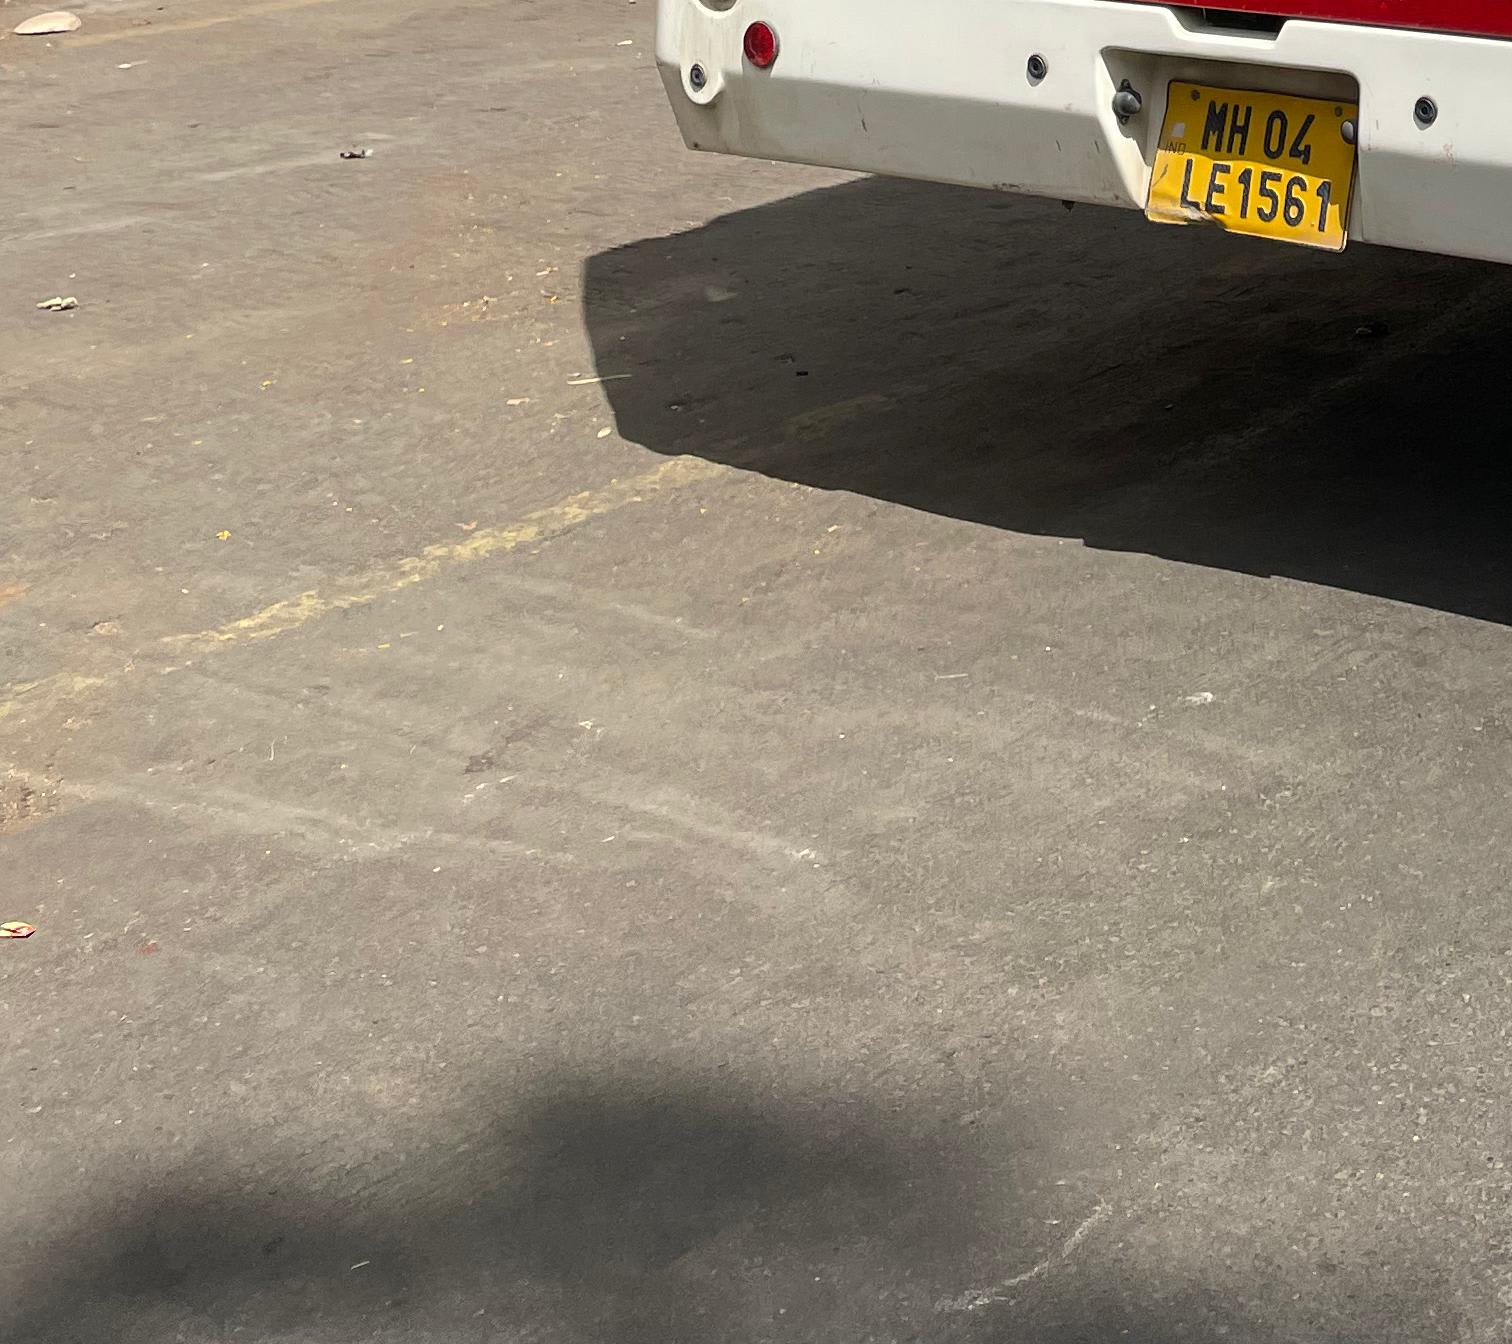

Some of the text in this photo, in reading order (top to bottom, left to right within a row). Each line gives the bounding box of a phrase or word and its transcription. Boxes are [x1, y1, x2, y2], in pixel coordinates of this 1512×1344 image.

[1200, 100, 1316, 165] MH 04
[1180, 159, 1332, 233] LE1561
